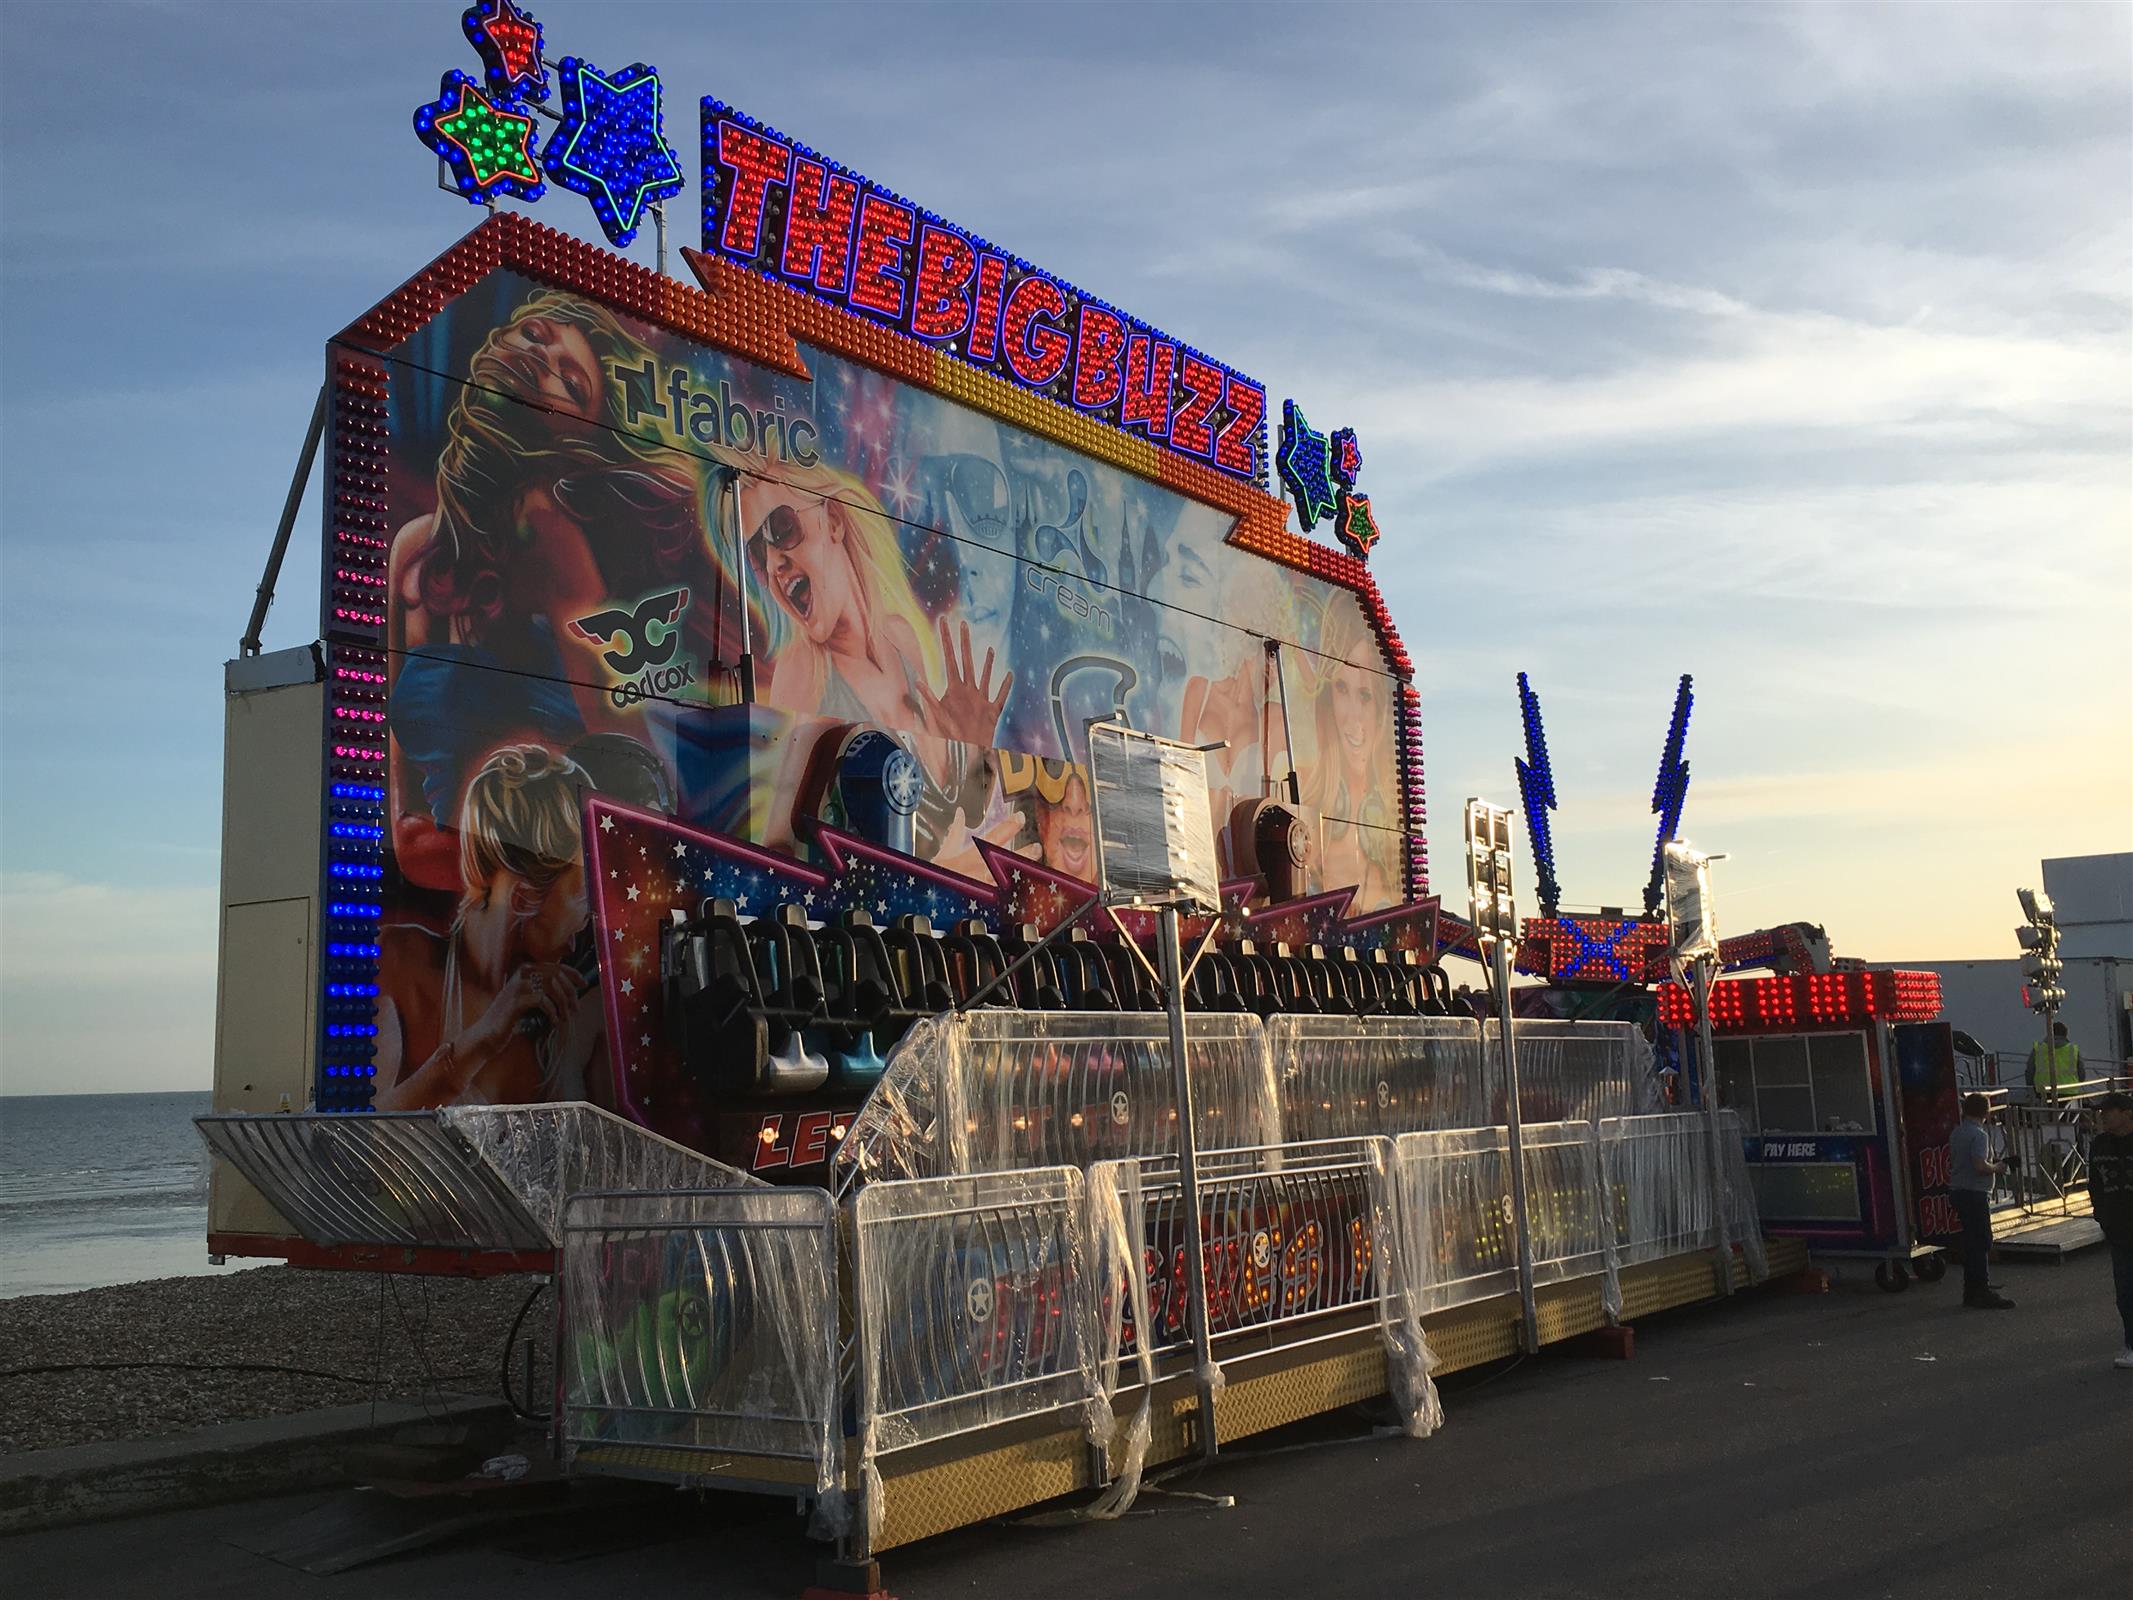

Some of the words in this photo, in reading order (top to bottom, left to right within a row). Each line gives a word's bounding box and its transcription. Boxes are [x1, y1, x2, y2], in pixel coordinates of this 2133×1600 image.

[718, 120, 916, 320] THE
[911, 224, 1071, 386] BIG
[1072, 304, 1267, 478] BUZZ
[668, 369, 820, 468] fabric
[1026, 565, 1111, 632] cream
[611, 669, 657, 708] carl
[654, 661, 696, 693] cox
[1764, 1142, 1785, 1157] PAY
[1787, 1142, 1816, 1157] HERE
